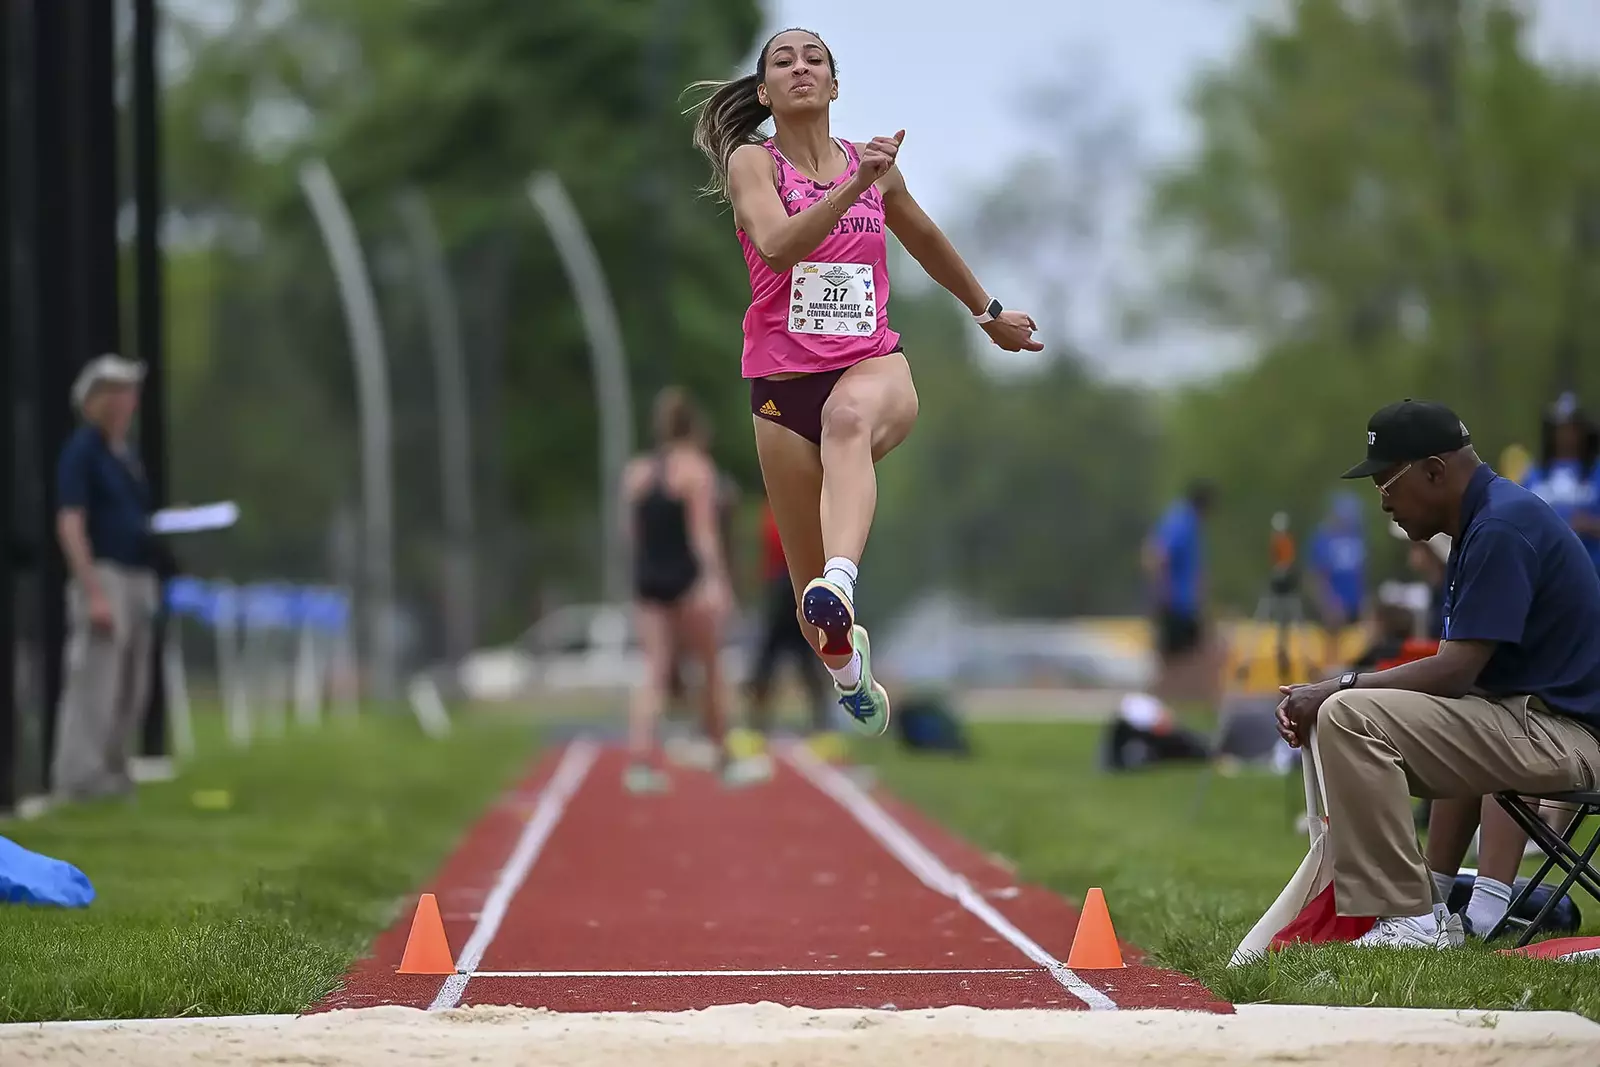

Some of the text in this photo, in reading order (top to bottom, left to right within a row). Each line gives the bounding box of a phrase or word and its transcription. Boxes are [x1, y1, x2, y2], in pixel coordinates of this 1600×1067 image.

[823, 288, 848, 302] 217
[840, 303, 860, 311] HAYLEY
[814, 319, 824, 330] E
